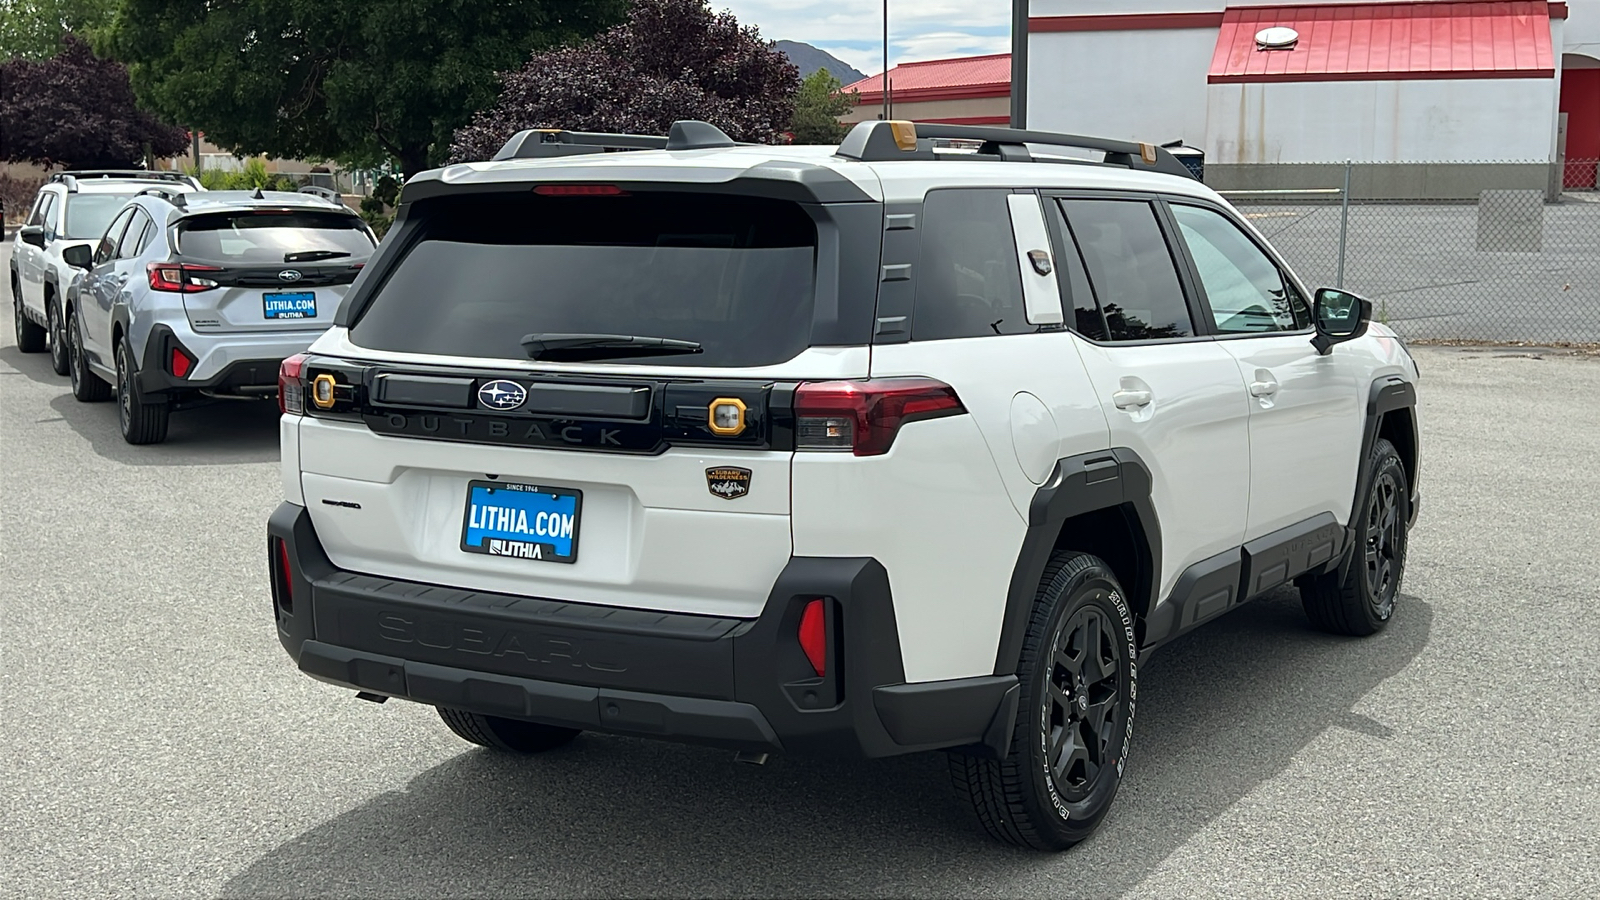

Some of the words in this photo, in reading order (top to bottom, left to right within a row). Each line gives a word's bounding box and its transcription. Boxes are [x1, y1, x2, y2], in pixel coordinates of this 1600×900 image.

[265, 300, 315, 311] LITHIA.COM
[386, 412, 622, 446] OUTBACK
[506, 483, 524, 492] SINCE
[525, 485, 539, 493] 1946
[469, 504, 575, 540] LITHIA.COM
[501, 540, 543, 559] LITHIA
[1108, 590, 1138, 778] BRIDGESTONE
